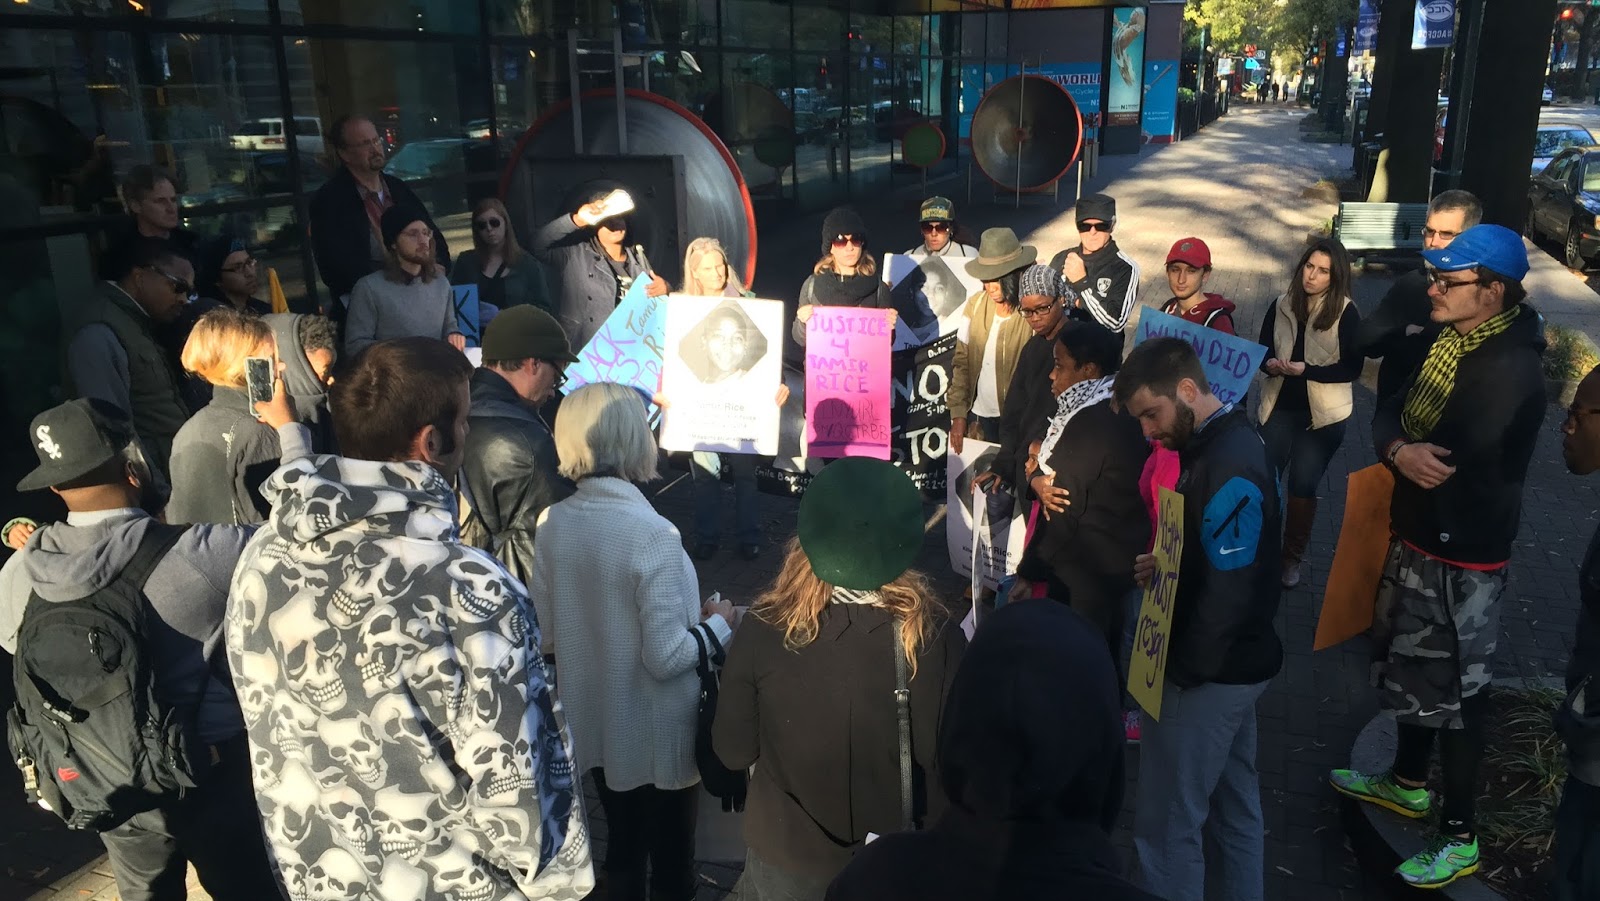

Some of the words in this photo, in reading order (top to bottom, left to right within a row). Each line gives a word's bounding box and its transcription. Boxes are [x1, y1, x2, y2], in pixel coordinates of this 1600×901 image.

[810, 312, 889, 338] JUSTICE
[830, 338, 850, 358] 4
[808, 353, 869, 372] TAMIR
[1207, 339, 1251, 380] DID
[816, 373, 870, 394] RICE
[724, 402, 745, 412] Rice
[1137, 613, 1166, 688] resign
